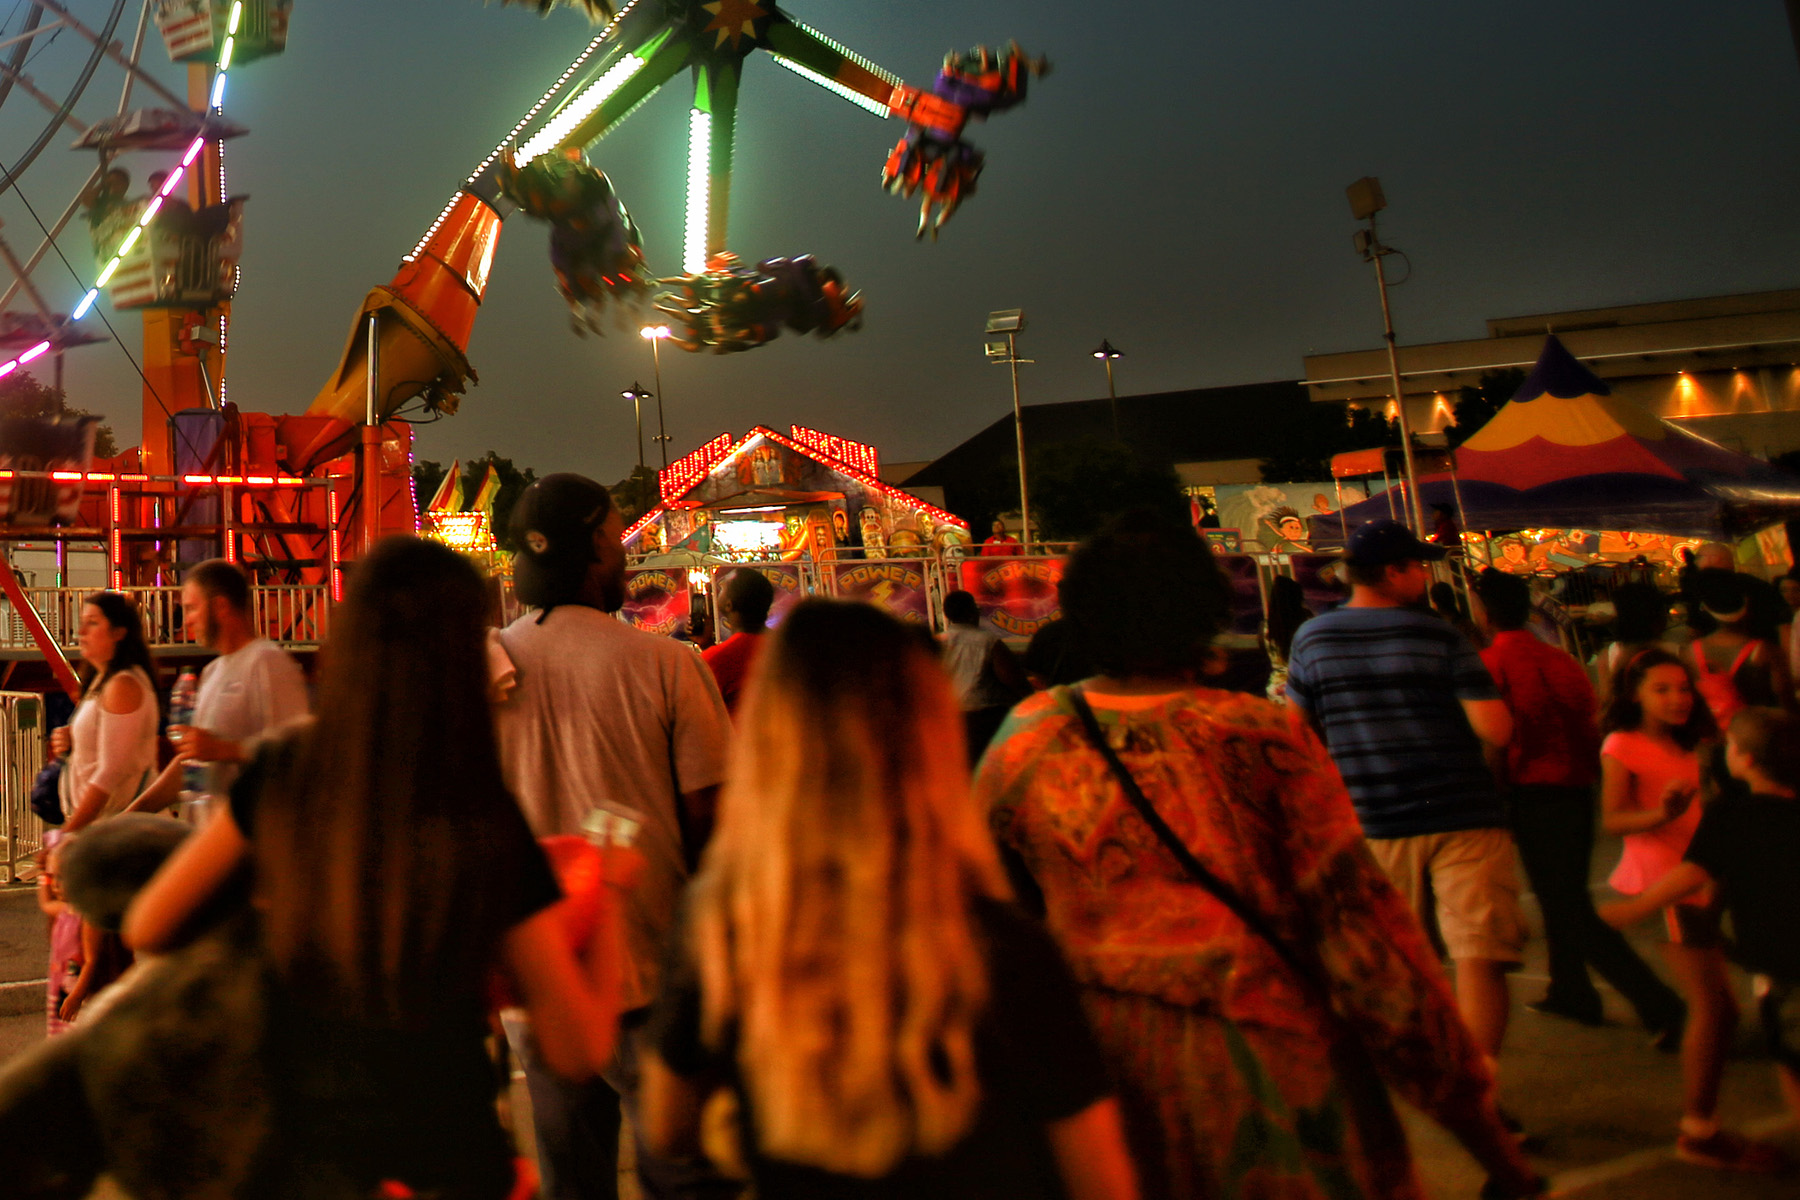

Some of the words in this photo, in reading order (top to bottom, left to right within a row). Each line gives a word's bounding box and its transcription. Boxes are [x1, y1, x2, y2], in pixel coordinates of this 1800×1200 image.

[658, 432, 732, 500] HAUNTED
[790, 424, 879, 479] MANSION
[628, 571, 678, 598] POWER
[837, 565, 924, 591] POWER
